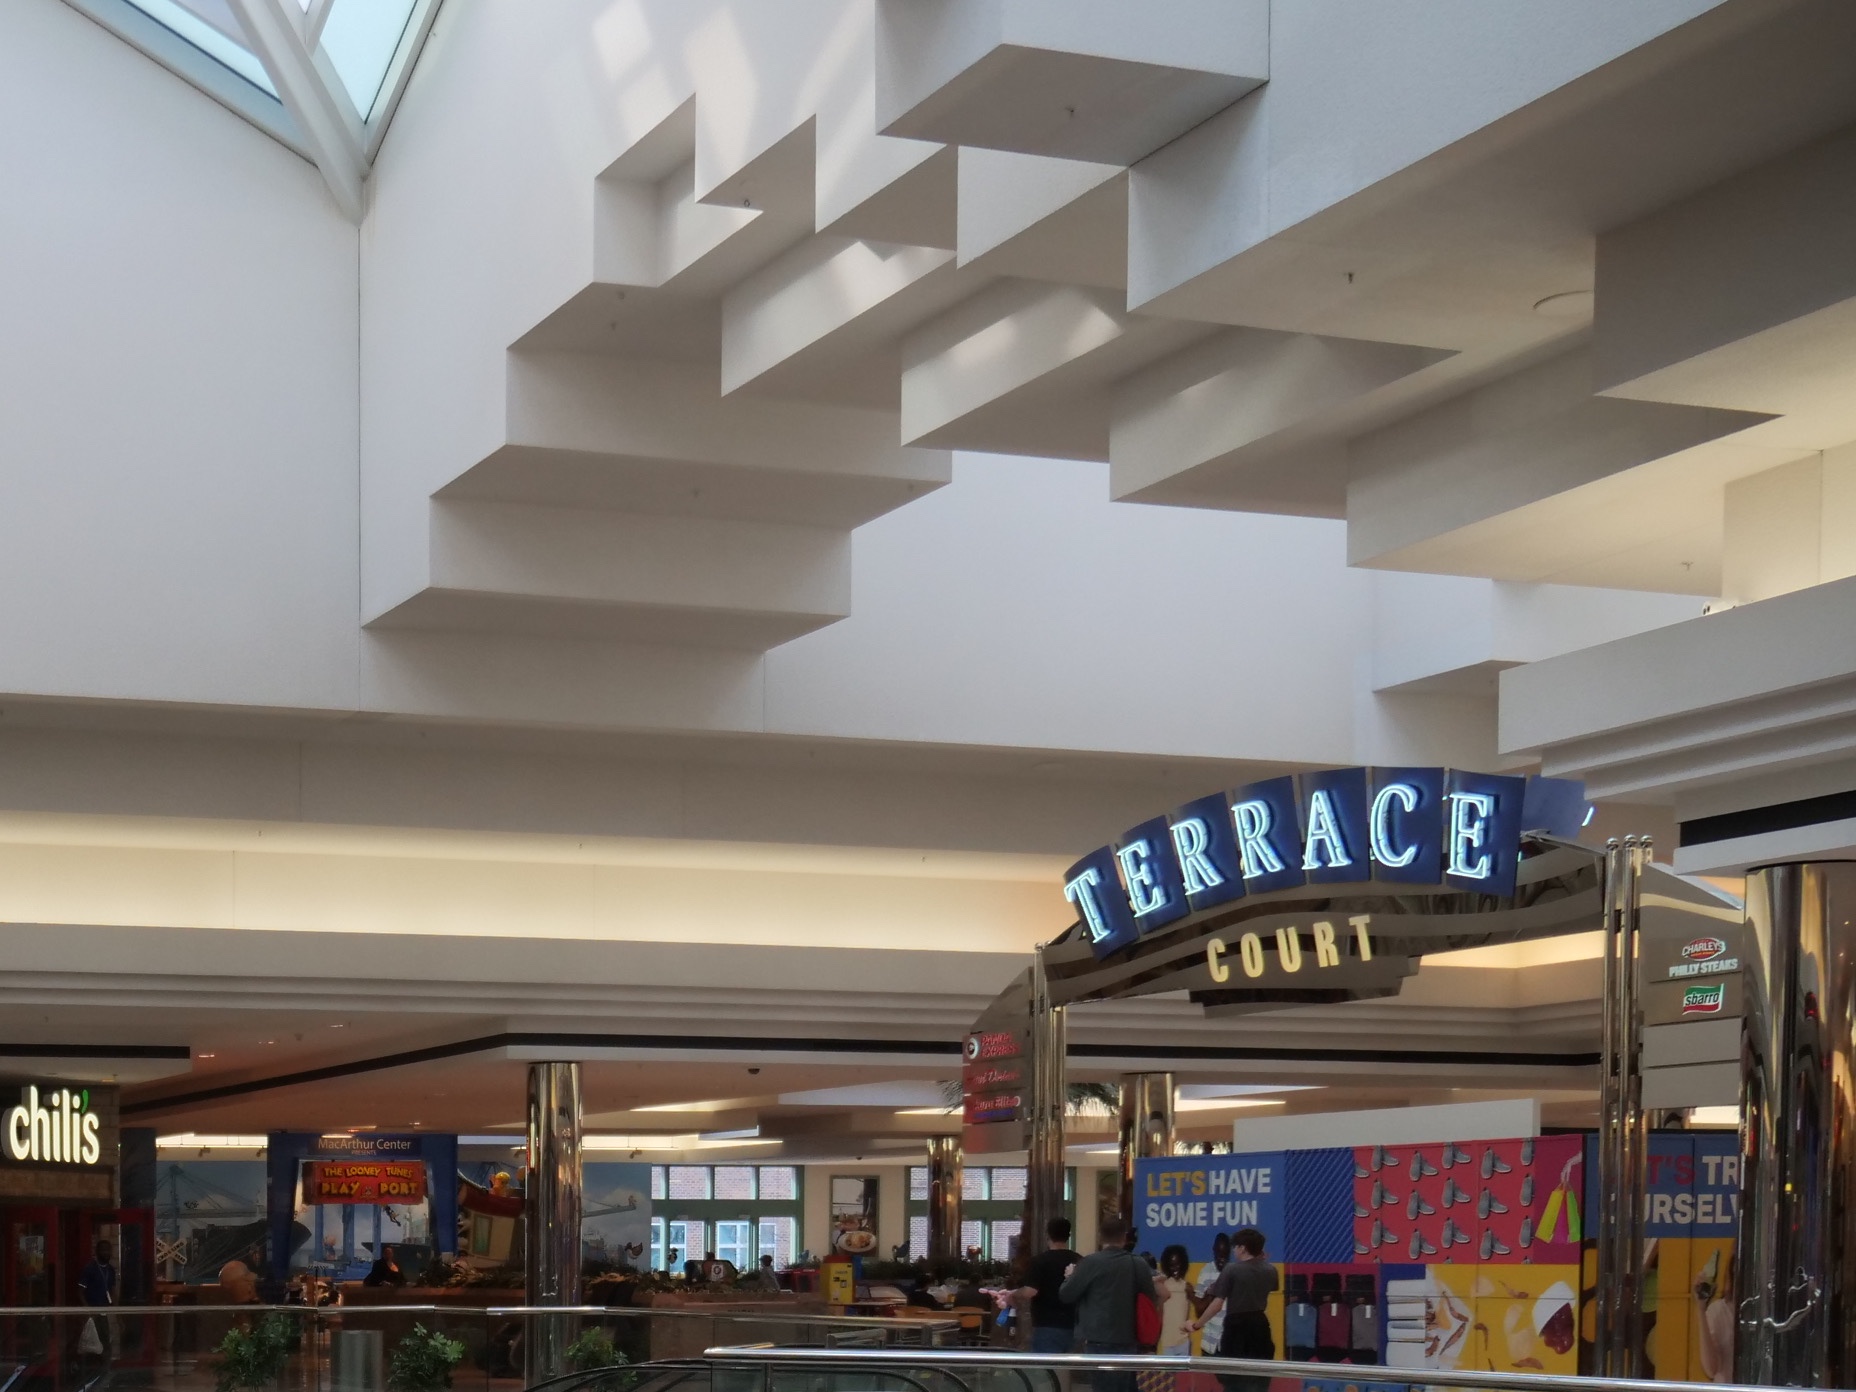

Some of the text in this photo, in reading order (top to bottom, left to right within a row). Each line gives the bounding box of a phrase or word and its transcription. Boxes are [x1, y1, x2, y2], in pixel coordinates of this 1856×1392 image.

[1064, 783, 1495, 944] TERRACE
[1207, 914, 1372, 983] COURT
[1669, 958, 1739, 978] PHILLY STEAKS
[1685, 992, 1721, 1006] sbarro
[6, 1085, 100, 1164] chili's
[318, 1138, 412, 1150] MacArthur Center
[324, 1166, 414, 1179] THE LOONEY TUNES
[1147, 1168, 1272, 1197] LET'S HAVE
[321, 1181, 419, 1195] PLAY PORT
[1146, 1200, 1258, 1227] SOME FUN
